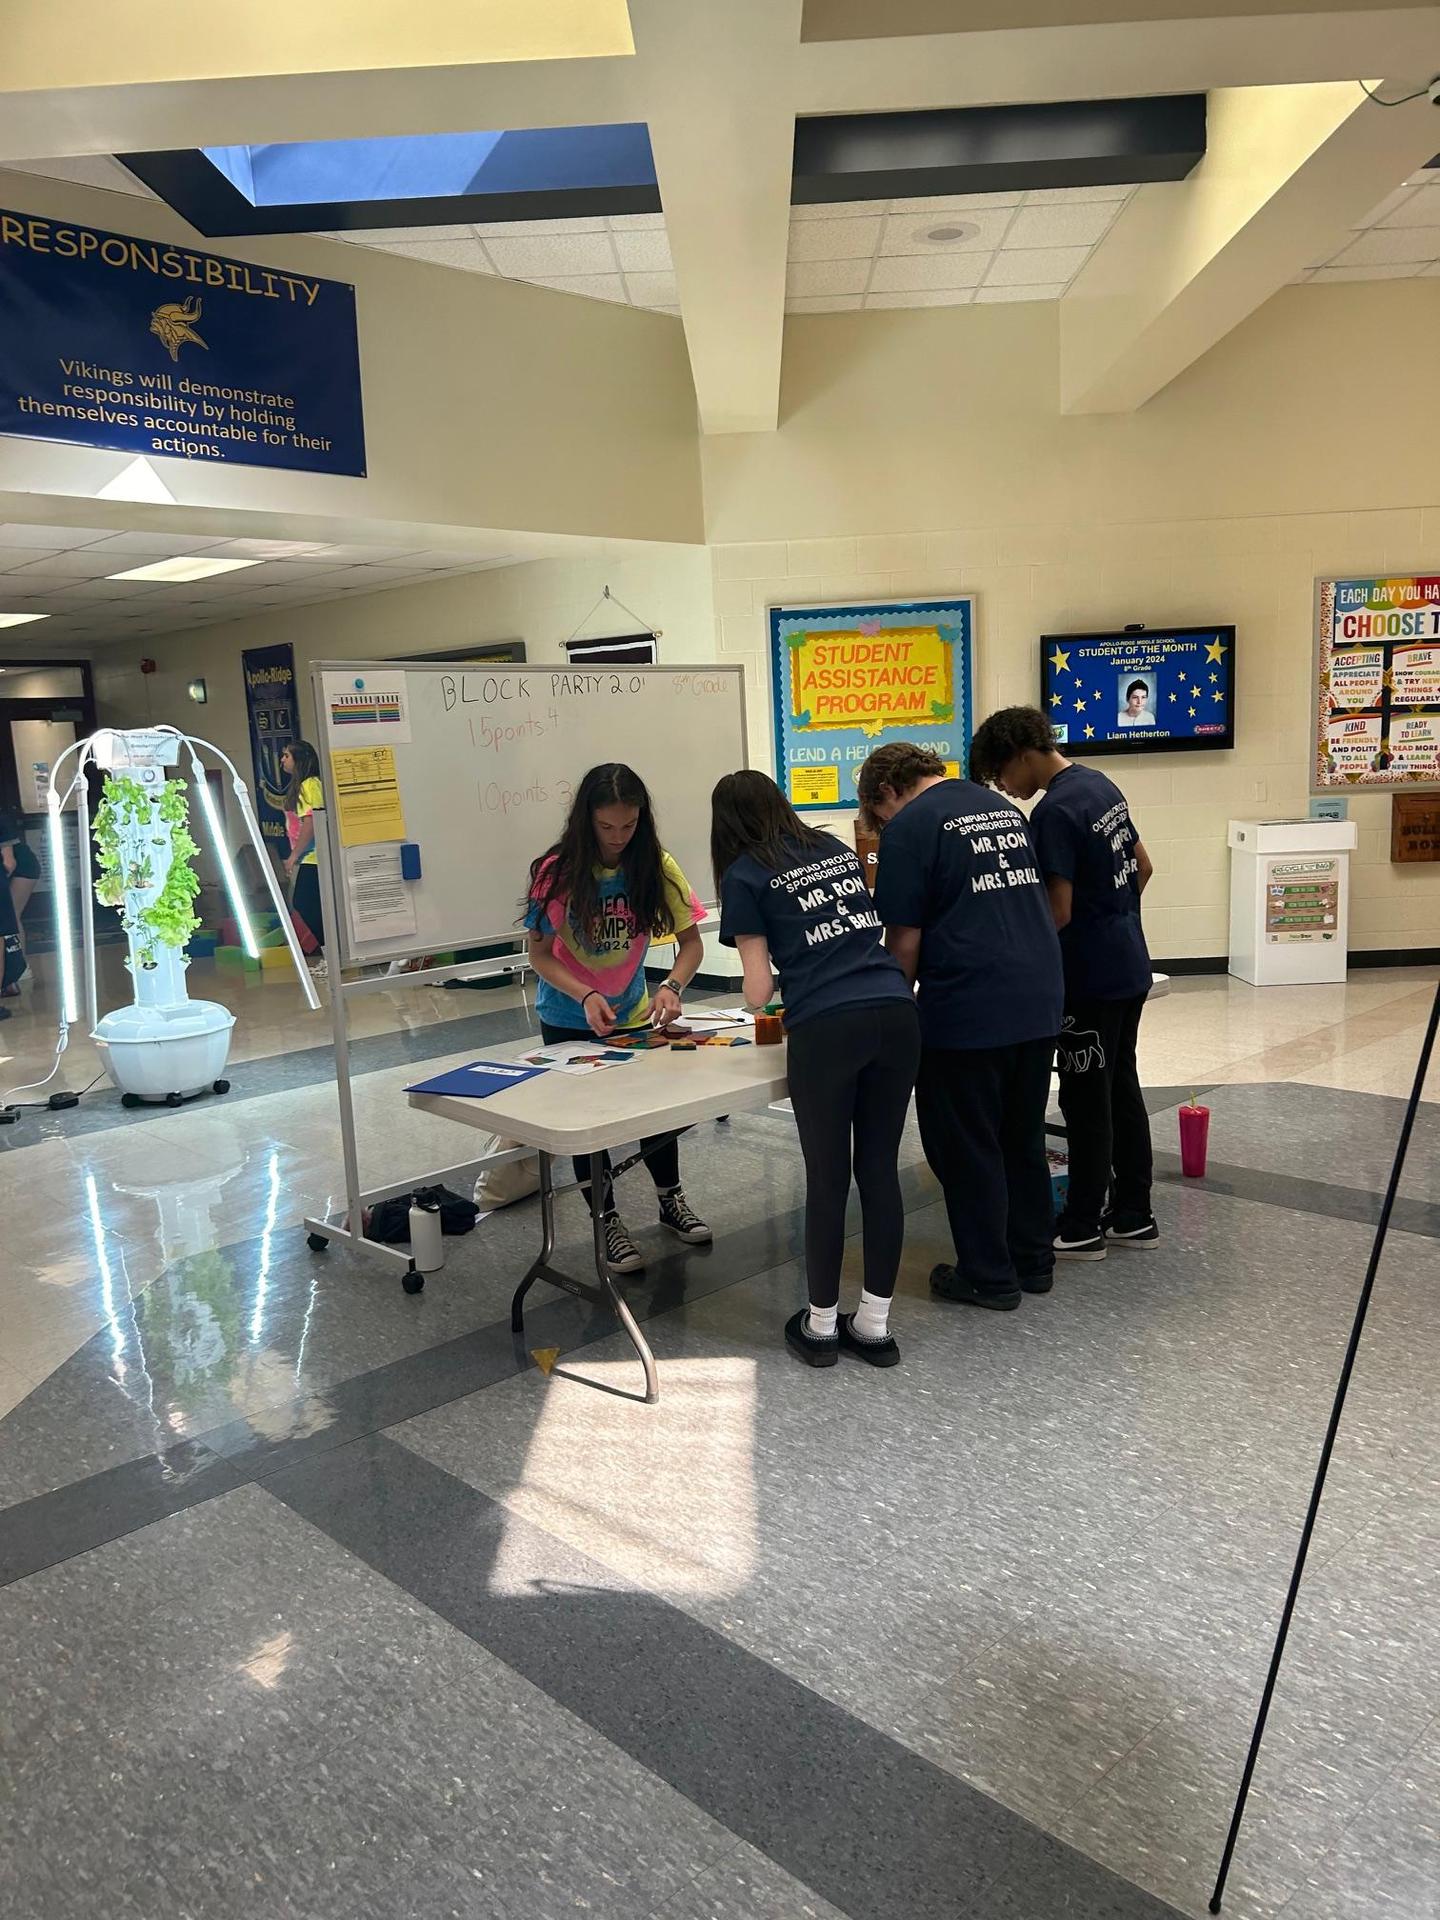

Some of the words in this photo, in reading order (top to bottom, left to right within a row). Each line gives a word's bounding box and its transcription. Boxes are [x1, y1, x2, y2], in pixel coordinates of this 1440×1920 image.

[1, 215, 321, 306] RESPONSIBILITY
[59, 358, 133, 387] Vikings
[139, 373, 173, 391] will
[178, 377, 295, 410] demonstrate
[63, 383, 197, 417] responsibility
[203, 403, 225, 422] by
[230, 405, 296, 431] holding
[18, 396, 139, 428] themselves
[144, 416, 257, 443] accountable
[262, 428, 289, 446] for
[292, 433, 332, 452] their
[151, 436, 226, 458] actions.
[1341, 588, 1368, 603] EACH
[1373, 587, 1396, 602] DAY
[1399, 585, 1420, 600] YOU
[1425, 584, 1440, 600] HA
[1343, 612, 1425, 638] CHOOSE
[1431, 611, 1440, 634] T
[813, 642, 913, 666] STUDENT
[1079, 647, 1123, 657] STUDENT
[1125, 646, 1139, 655] OF
[1141, 645, 1160, 654] THE
[1162, 643, 1197, 653] MONTH
[1334, 653, 1380, 666] ACCEPTING
[1408, 651, 1432, 663] BRAVE
[1110, 657, 1144, 666] January
[1146, 655, 1165, 663] 2024
[803, 665, 938, 690] ASSISTANCE
[441, 675, 530, 712] BLOCK
[551, 674, 603, 697] PARTY
[816, 691, 927, 715] PROGRAM
[1395, 695, 1440, 703] REGULARLY
[1107, 732, 1127, 740] Liam
[1129, 730, 1170, 739] Hetherton
[1345, 721, 1366, 732] KIND
[1406, 721, 1427, 730] READY
[1411, 729, 1432, 738] LEARN
[790, 747, 826, 762] LEND
[831, 747, 842, 761] A
[943, 813, 988, 831] OLYMPIAD
[959, 819, 1012, 836] SPONSORED
[1012, 818, 1022, 828] BY
[970, 836, 997, 854] MR.
[996, 832, 1028, 850] RON
[998, 853, 1010, 869] &
[770, 863, 820, 889] OLYMPIAD
[786, 865, 847, 893] SPONSORED
[848, 861, 861, 871] BY
[971, 872, 1006, 893] MRS.
[1006, 868, 1040, 887] BRILL
[797, 888, 834, 912] MR.
[831, 876, 866, 897] RON
[836, 899, 850, 916] &
[805, 919, 850, 946] MRS.
[848, 910, 882, 929] BRILL
[595, 940, 631, 953] 2024
